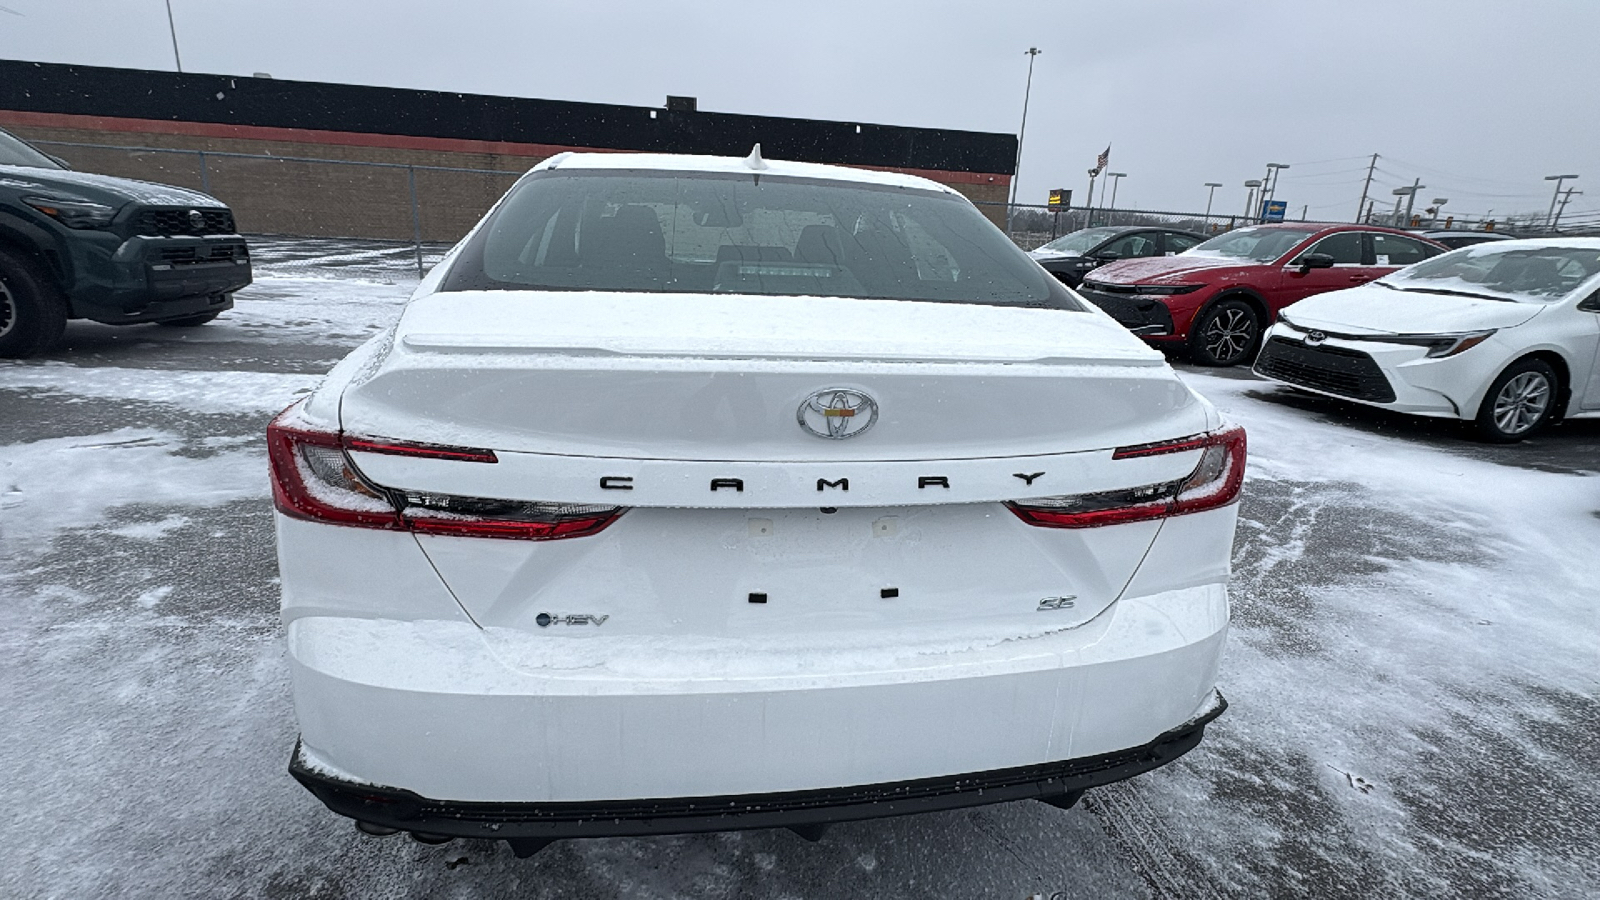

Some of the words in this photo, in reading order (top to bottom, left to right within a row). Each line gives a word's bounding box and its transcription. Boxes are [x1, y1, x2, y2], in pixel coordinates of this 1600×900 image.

[599, 471, 1047, 493] CAMRY
[1036, 595, 1077, 611] SE
[551, 613, 609, 627] HEV
